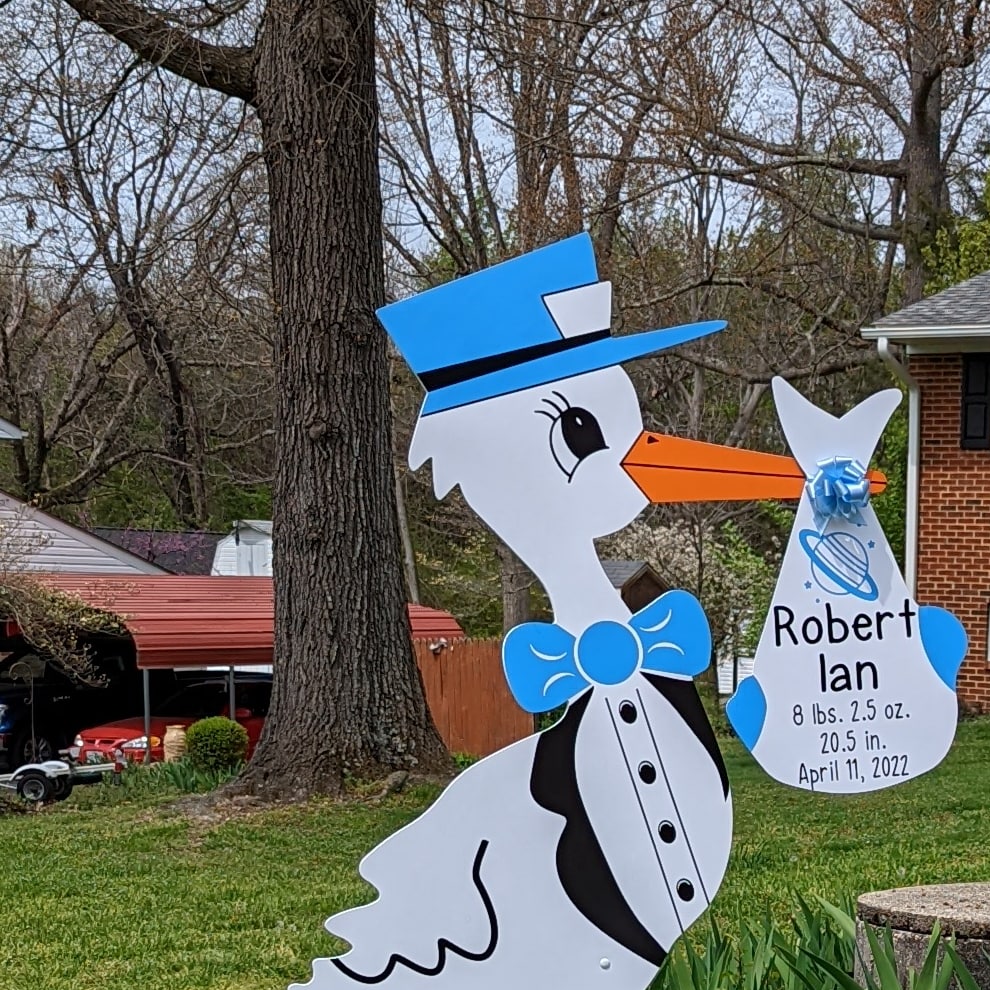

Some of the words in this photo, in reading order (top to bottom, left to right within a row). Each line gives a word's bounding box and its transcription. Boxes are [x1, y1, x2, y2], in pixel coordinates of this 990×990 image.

[773, 598, 916, 647] Robert
[819, 653, 879, 693] Ian
[792, 704, 804, 726] 8
[812, 702, 844, 725] lbs.
[850, 698, 877, 723] 2.5
[884, 702, 910, 720] oz.
[820, 730, 857, 754] 20.5
[865, 730, 887, 750] in.
[798, 759, 840, 791] April
[845, 757, 866, 783] 11,
[872, 754, 910, 783] 2022
